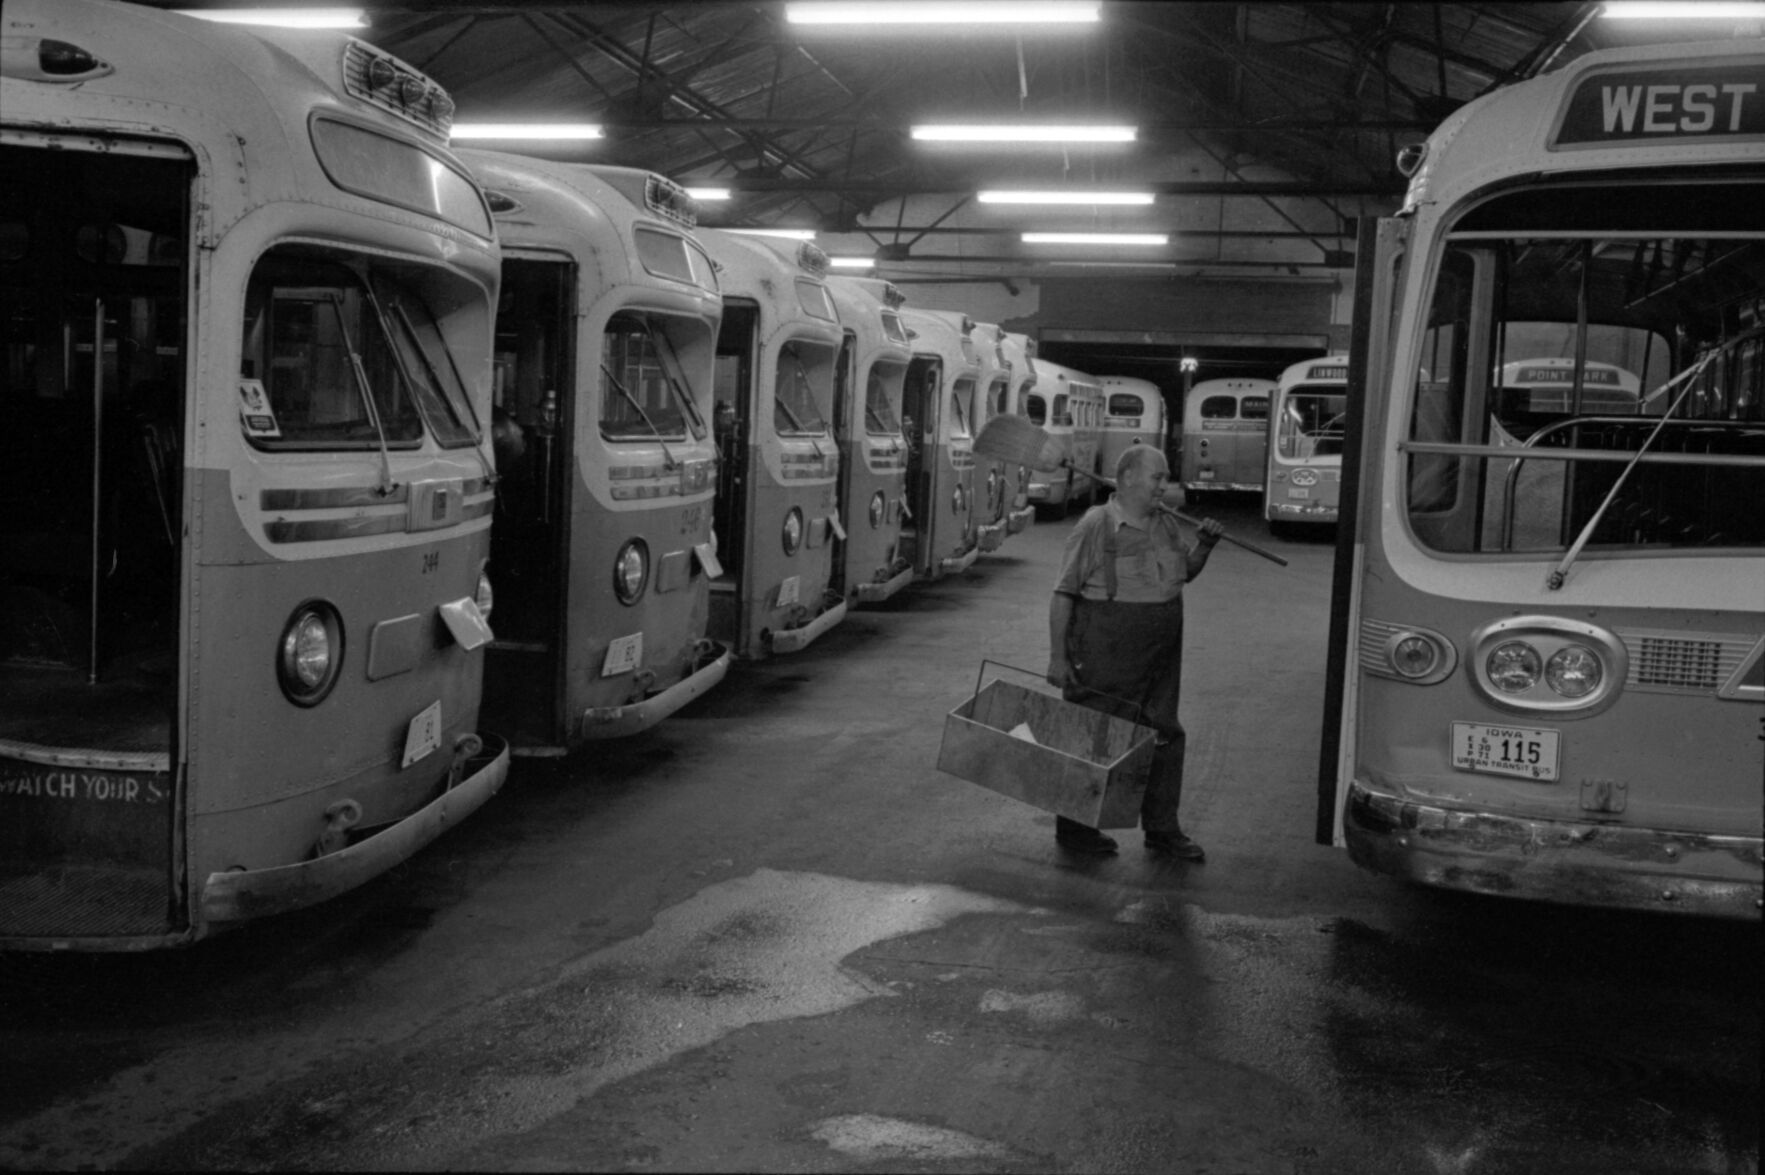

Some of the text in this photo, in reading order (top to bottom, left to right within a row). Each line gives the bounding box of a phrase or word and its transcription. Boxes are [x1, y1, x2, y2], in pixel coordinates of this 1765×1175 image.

[1601, 83, 1757, 132] WEST
[1528, 369, 1608, 382] POINT ARK
[422, 551, 440, 574] 244
[1486, 729, 1523, 738] IOWA
[1501, 740, 1541, 764] 115
[1457, 757, 1489, 766] URBAN
[1491, 761, 1529, 771] TRANSIT
[80, 774, 139, 802] YOUR
